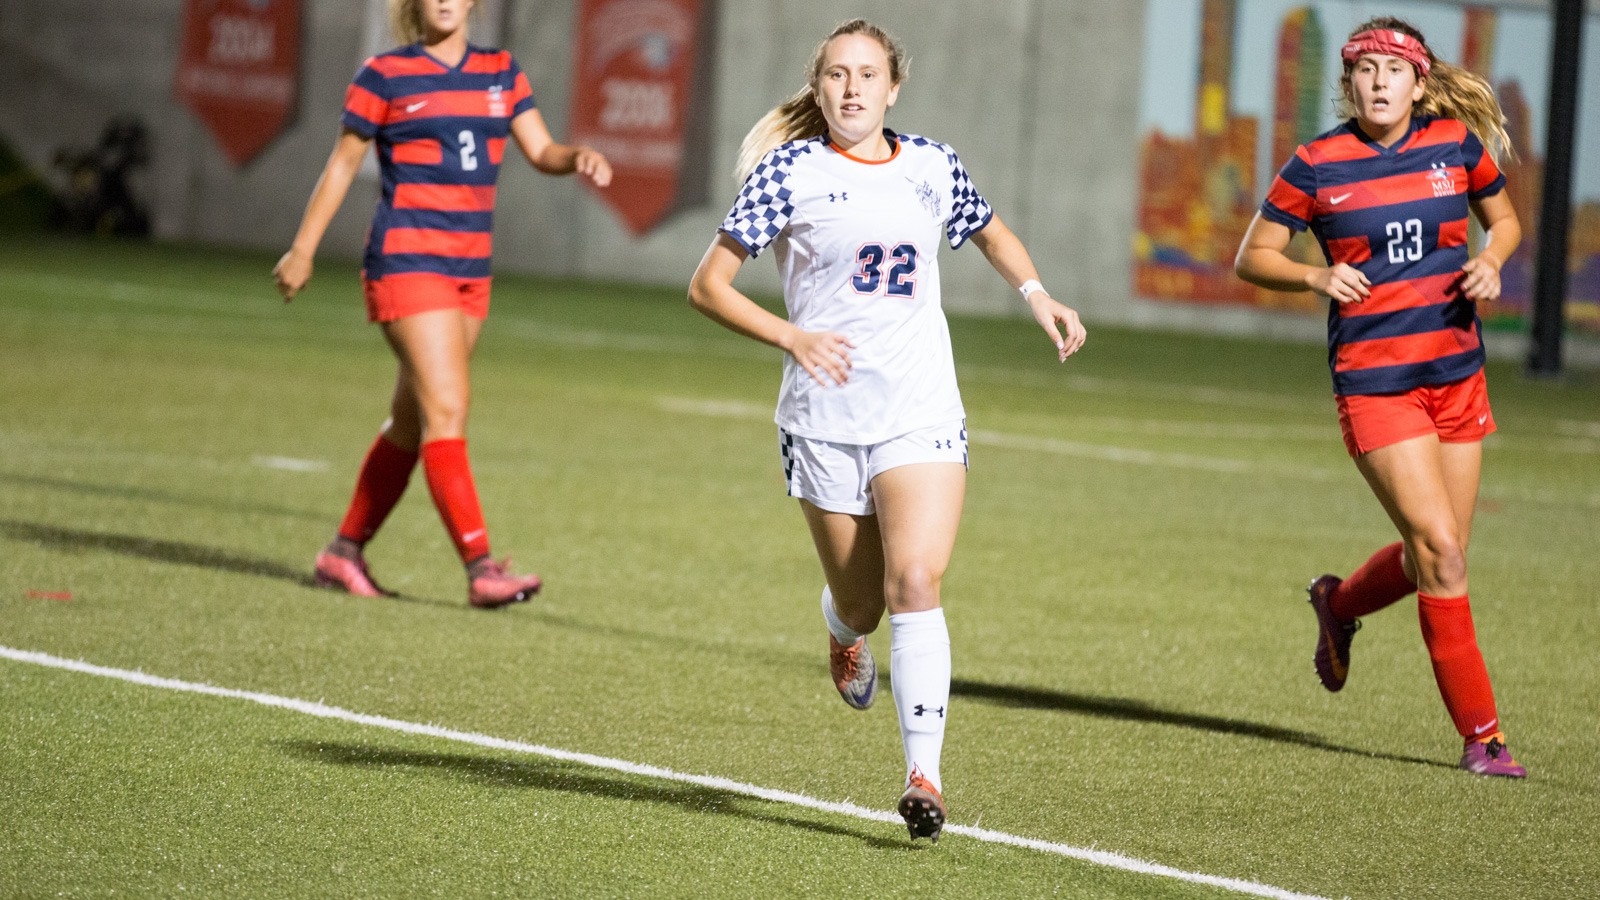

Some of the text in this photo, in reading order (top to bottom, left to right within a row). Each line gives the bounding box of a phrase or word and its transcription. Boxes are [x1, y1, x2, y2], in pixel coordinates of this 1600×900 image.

[458, 130, 478, 171] 2
[1432, 179, 1455, 191] MSU
[1385, 218, 1423, 264] 23
[850, 241, 919, 299] 32
